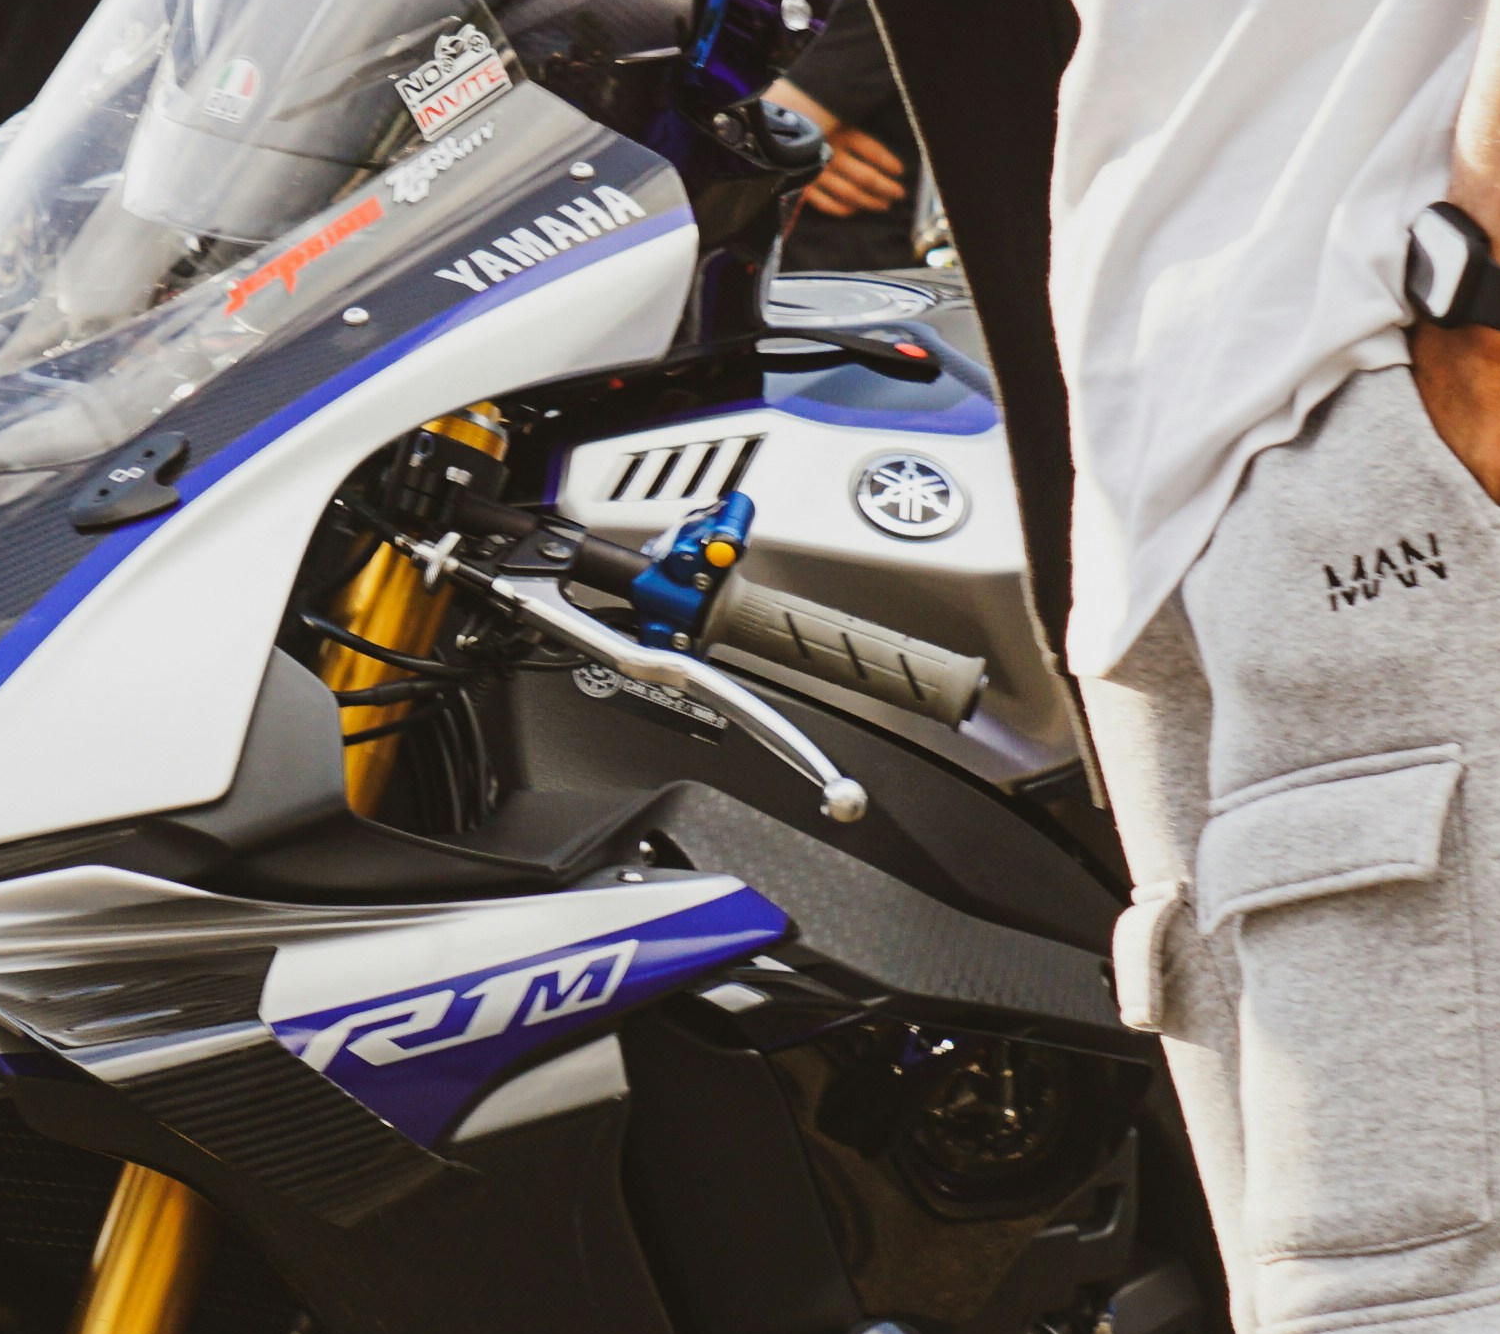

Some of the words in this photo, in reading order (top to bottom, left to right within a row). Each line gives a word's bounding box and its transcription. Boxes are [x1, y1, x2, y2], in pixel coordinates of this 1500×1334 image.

[402, 65, 442, 101] NO
[414, 59, 504, 130] INVITE
[434, 185, 647, 293] YAMAHA
[300, 938, 641, 1072] R1M
